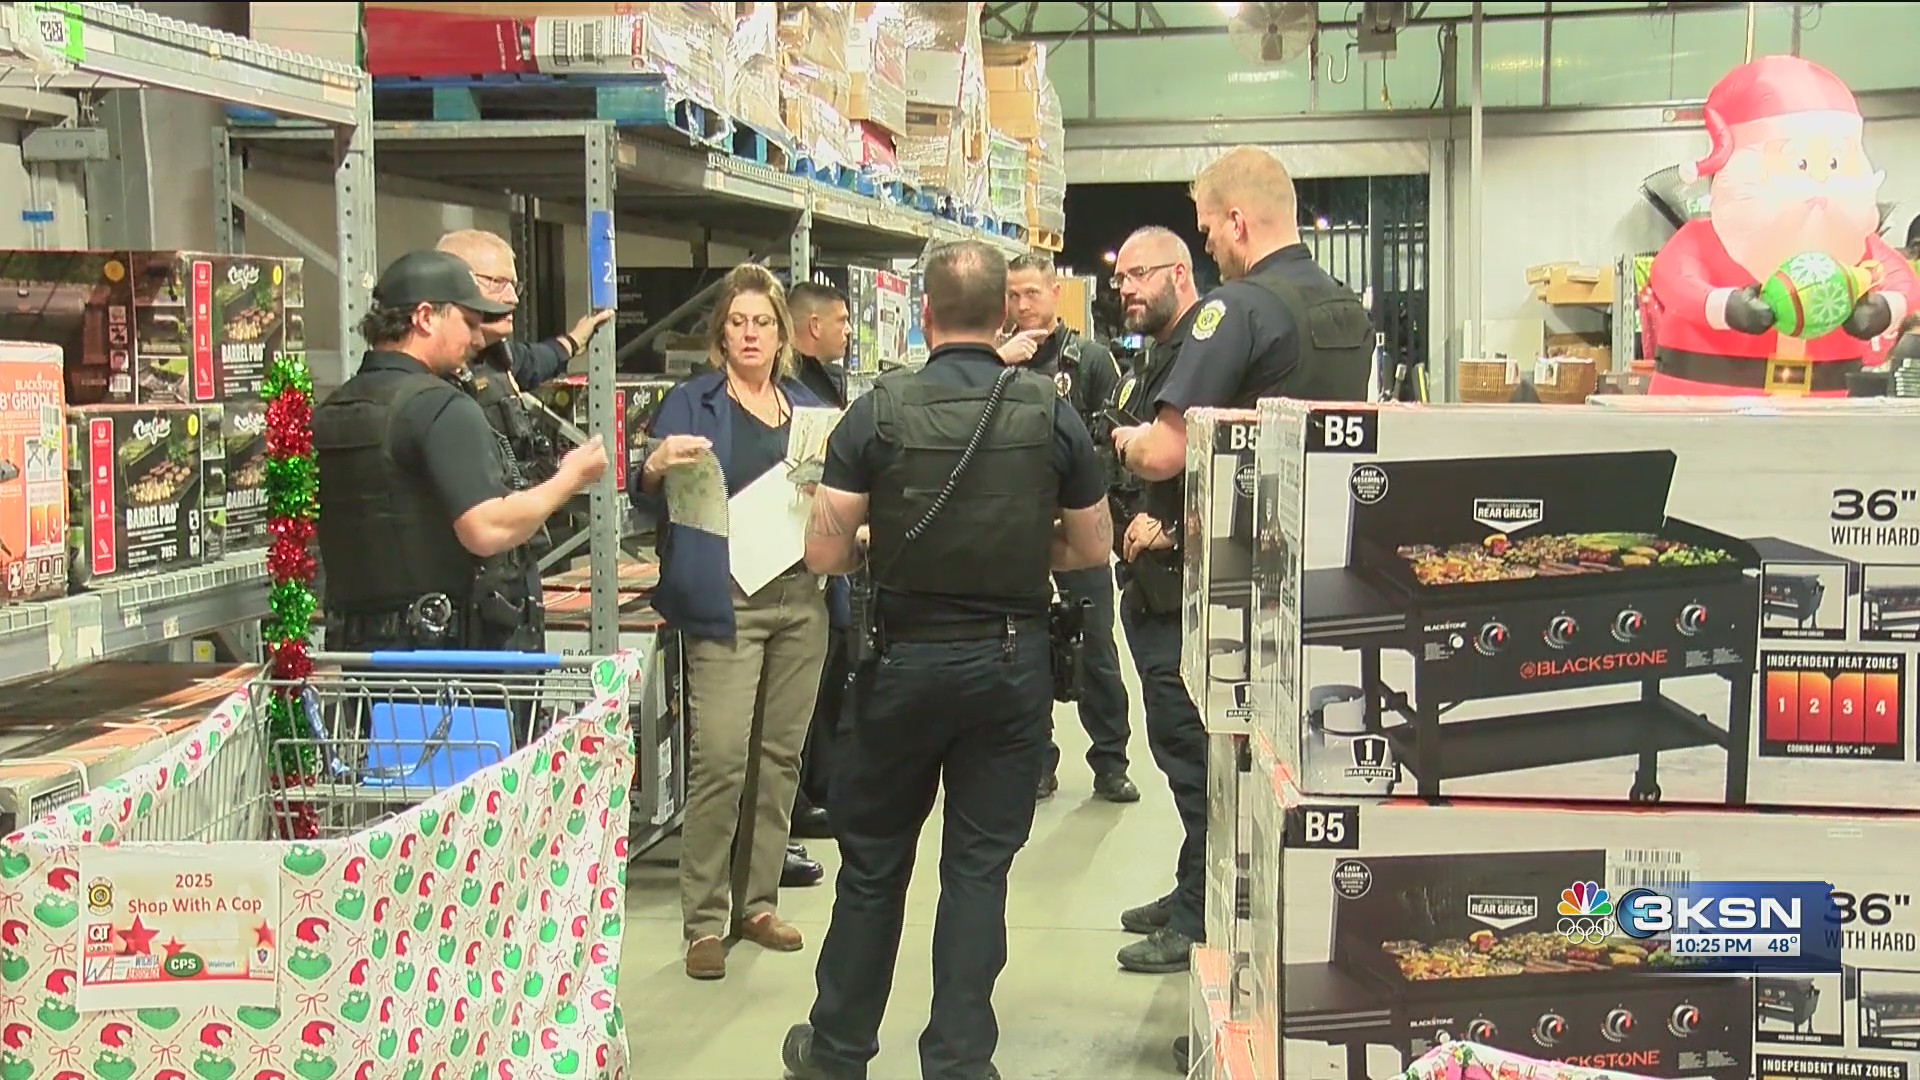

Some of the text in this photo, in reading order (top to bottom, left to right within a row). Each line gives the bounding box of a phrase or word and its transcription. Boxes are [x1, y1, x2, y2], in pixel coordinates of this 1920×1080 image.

[15, 380, 60, 390] BLACKSTONE
[1325, 415, 1364, 448] B5
[1353, 476, 1385, 484] ASSEMBLY
[1361, 469, 1377, 477] EASY
[1478, 508, 1539, 519] REAR GREASE
[1831, 489, 1917, 522] 36"
[126, 505, 159, 530] BARREL
[1831, 526, 1920, 546] WITH HARD
[1424, 621, 1467, 631] BLACKSTONE
[1537, 649, 1668, 676] BLACKSTONE
[1766, 654, 1898, 669] INDEPENDENT HEAT ZONES
[1778, 697, 1886, 715] 1 2 3 4
[1365, 739, 1373, 760] 1
[1348, 769, 1392, 777] WARRANTY
[1305, 811, 1345, 843] B5
[175, 873, 213, 888] 2025
[128, 896, 262, 915] Shop With A Cop
[1472, 904, 1533, 915] REAR GREASE
[1824, 891, 1910, 926] 36"
[1825, 929, 1916, 952] WITH HARD
[170, 958, 197, 971] CPS
[1410, 1017, 1453, 1028] BLACKSTONE
[1556, 1049, 1660, 1069] CKSTONE
[1763, 1058, 1900, 1079] INDEPENDENT HEAT ZONES
